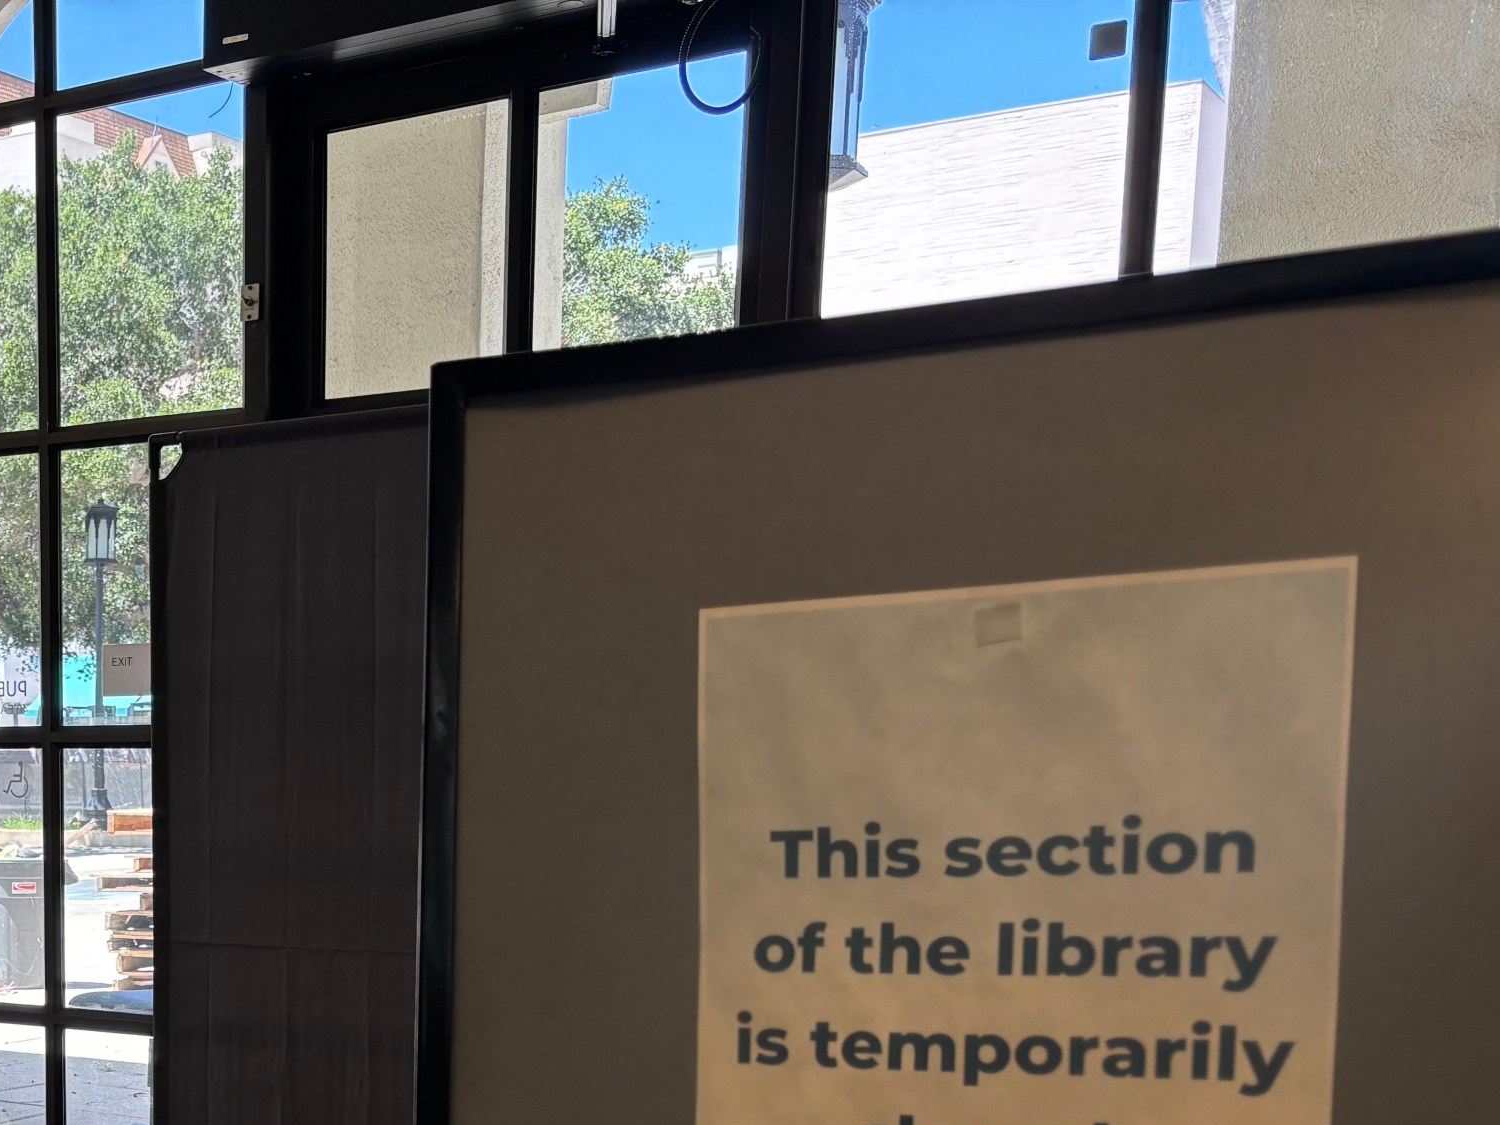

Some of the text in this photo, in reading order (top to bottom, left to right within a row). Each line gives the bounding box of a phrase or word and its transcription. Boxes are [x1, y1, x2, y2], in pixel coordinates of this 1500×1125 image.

[111, 656, 133, 667] EXIT
[770, 815, 1257, 878] This section
[753, 917, 1278, 993] of the library
[736, 1009, 1297, 1098] is temporarily
